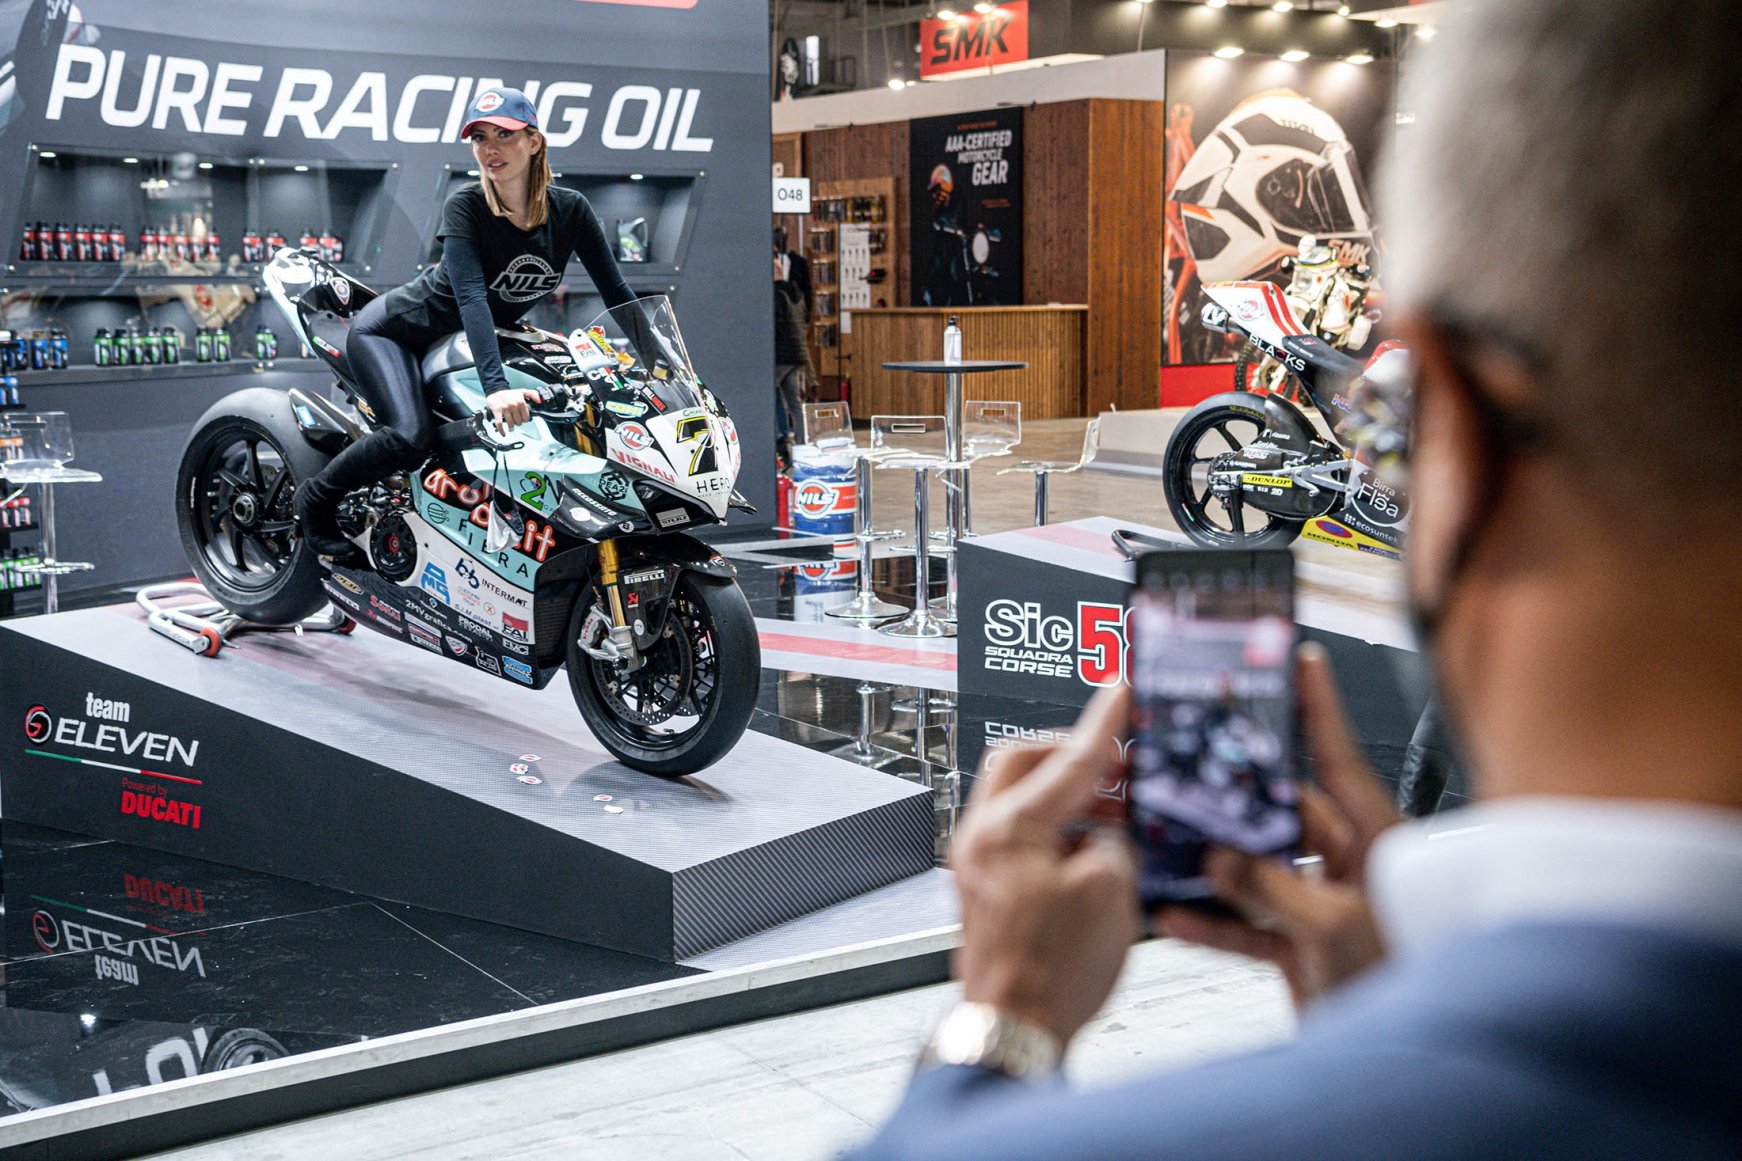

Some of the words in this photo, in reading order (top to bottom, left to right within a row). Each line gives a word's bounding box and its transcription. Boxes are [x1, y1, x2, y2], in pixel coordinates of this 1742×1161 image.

[930, 16, 1013, 66] SMK
[46, 44, 264, 136] PURE
[601, 85, 714, 152] OIL
[945, 129, 1013, 152] AAA-CERTIFIED
[957, 149, 1004, 164] MOTORCYCLE
[972, 160, 1009, 186] GEAR
[498, 272, 560, 291] NILS
[614, 427, 654, 446] NILS
[676, 415, 720, 477] 7
[611, 447, 676, 483] VIGNALI
[696, 476, 731, 495] HERO
[1250, 476, 1291, 486] DUNLOP
[1372, 476, 1396, 497] Birra
[796, 491, 837, 506] NILS
[1306, 531, 1355, 549] HONDA
[1356, 521, 1399, 545] ecosuntek
[624, 569, 665, 585] PIRELLI
[481, 577, 529, 609] INTERMAT
[984, 599, 1074, 652] Sic
[1077, 600, 1137, 688] 5
[984, 645, 1073, 665] SQUADRA
[984, 656, 1074, 678] CORSE
[86, 692, 129, 723] team
[54, 717, 199, 766] ELEVEN
[121, 776, 154, 794] Powered
[156, 783, 169, 797] by
[121, 790, 201, 829] DUCATI
